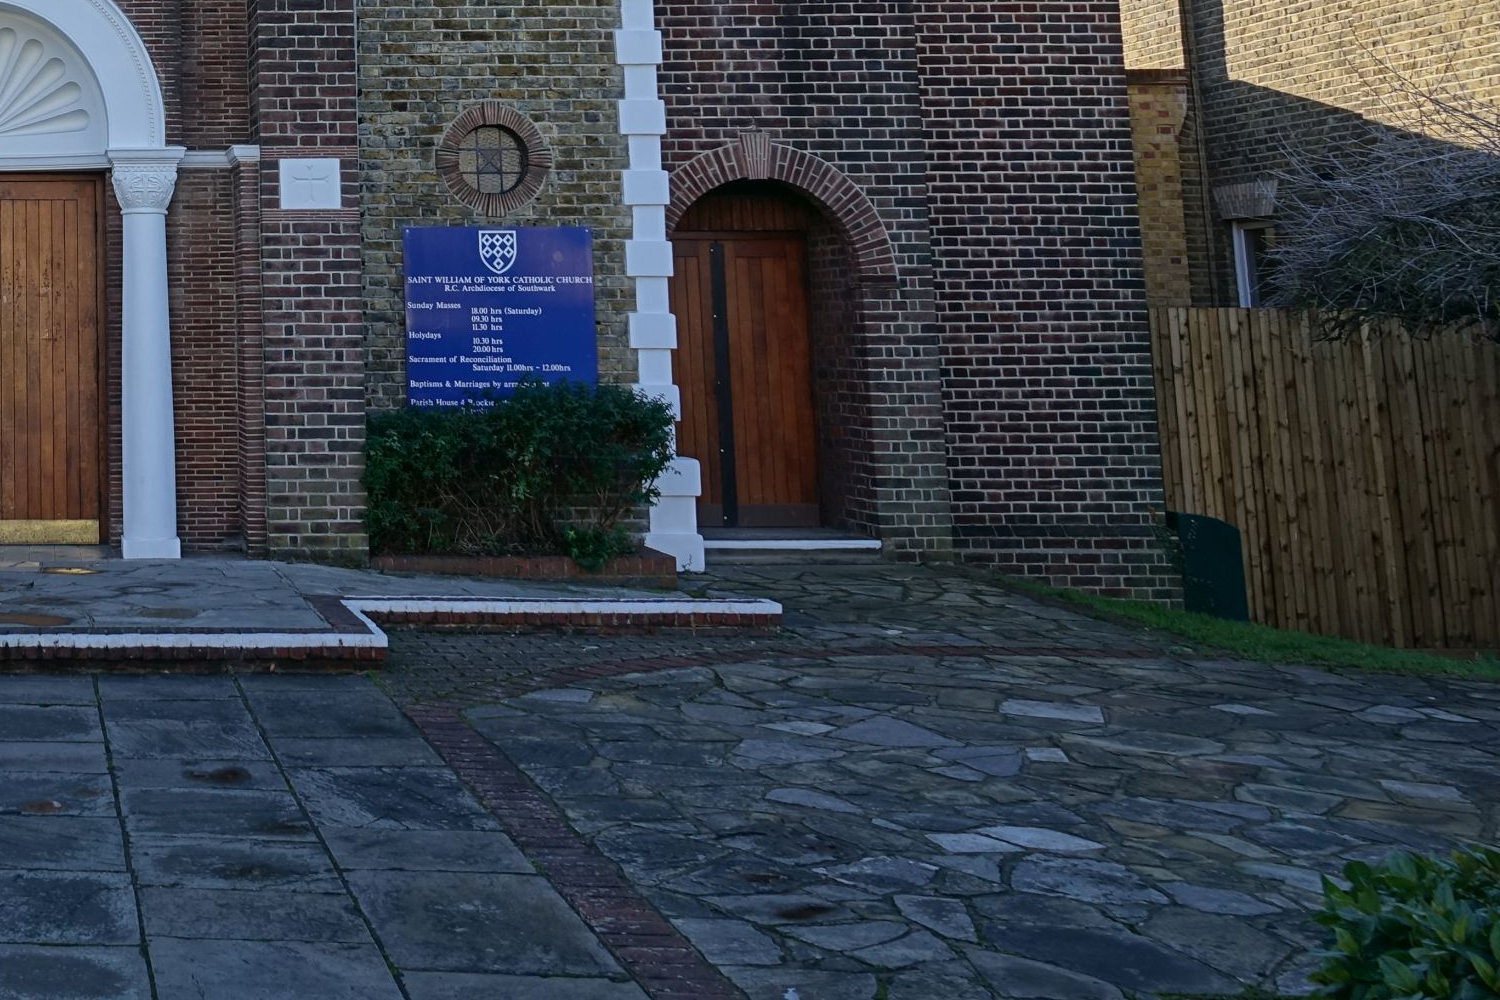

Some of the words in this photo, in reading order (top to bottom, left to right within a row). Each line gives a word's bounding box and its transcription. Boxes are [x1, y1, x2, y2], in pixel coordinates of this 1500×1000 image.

[407, 276, 433, 284] SAINT
[434, 276, 472, 284] WILLIAM
[473, 276, 486, 284] OF
[487, 276, 511, 284] YORK
[512, 276, 555, 284] CATHOLIC
[555, 276, 593, 284] CHURCH
[444, 284, 460, 292] R.C.
[462, 284, 506, 292] Archdiocese
[507, 284, 516, 292] of
[517, 284, 556, 292] Southwark
[407, 301, 434, 310] Sunday
[436, 301, 462, 309] Masses
[471, 307, 489, 315] 18.00
[490, 307, 503, 315] hrs
[504, 307, 543, 316] (Saturday)
[471, 315, 490, 323] 09.30
[490, 315, 503, 323] hrs
[472, 323, 488, 331] 11.30
[490, 323, 503, 331] hrs
[408, 331, 442, 340] Holydays
[472, 337, 490, 345] 10.30
[491, 337, 504, 345] hrs
[491, 345, 504, 353] hrs
[408, 355, 447, 363] Sacrament
[448, 355, 458, 363] of
[460, 355, 513, 363] Reconciliation
[472, 363, 505, 372] Saturday
[409, 380, 443, 389] Baptisms
[444, 380, 452, 388] &
[453, 380, 491, 389] Marriages
[492, 380, 502, 389] by
[410, 398, 434, 406] Parish
[436, 398, 459, 406] House
